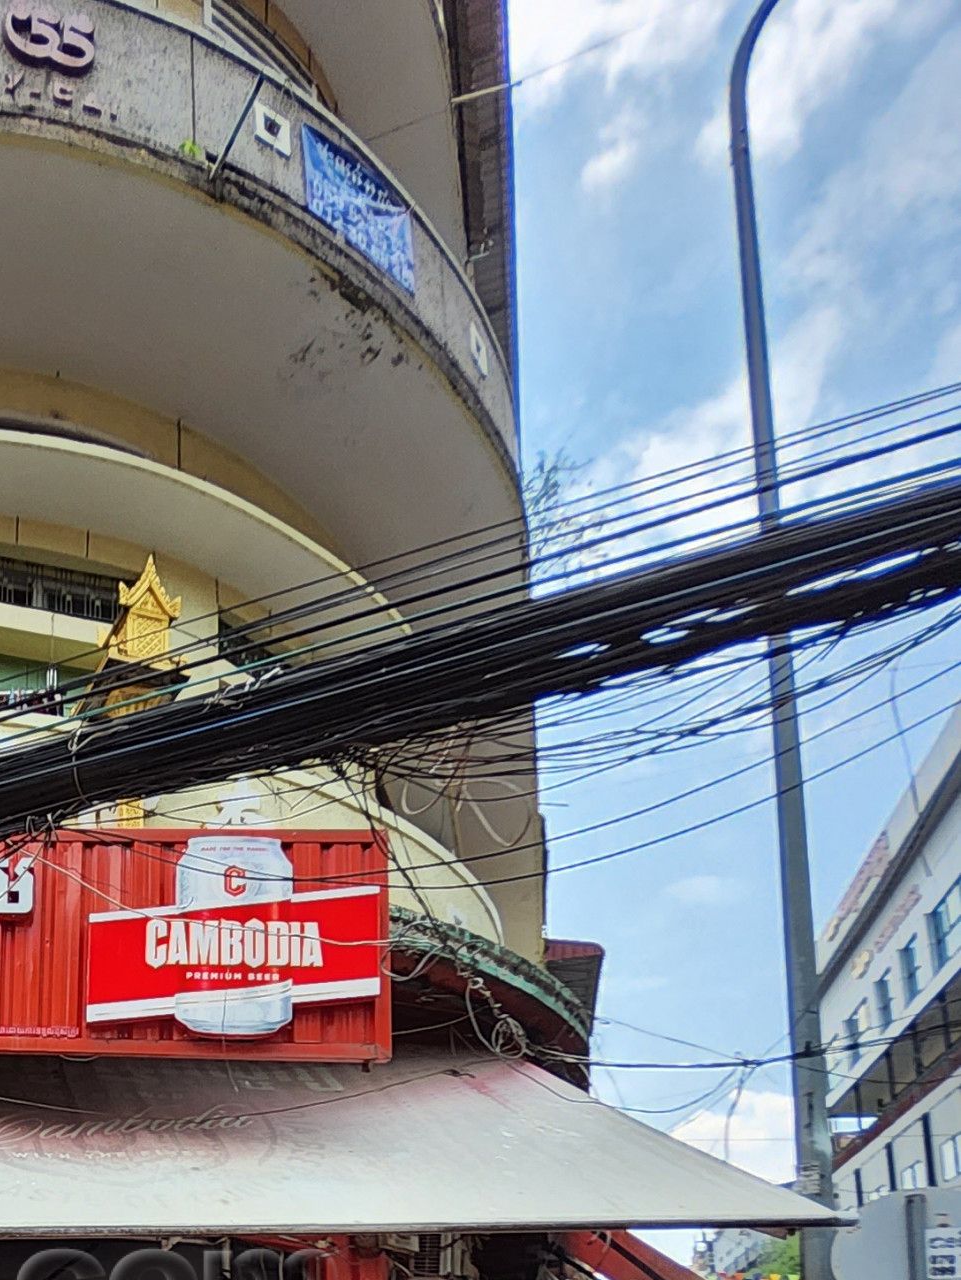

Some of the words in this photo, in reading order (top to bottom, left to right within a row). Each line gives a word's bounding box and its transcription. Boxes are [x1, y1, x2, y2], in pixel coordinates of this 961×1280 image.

[145, 917, 324, 968] CAMBODIA
[185, 971, 242, 981] PREMIUM
[247, 972, 280, 981] BEER
